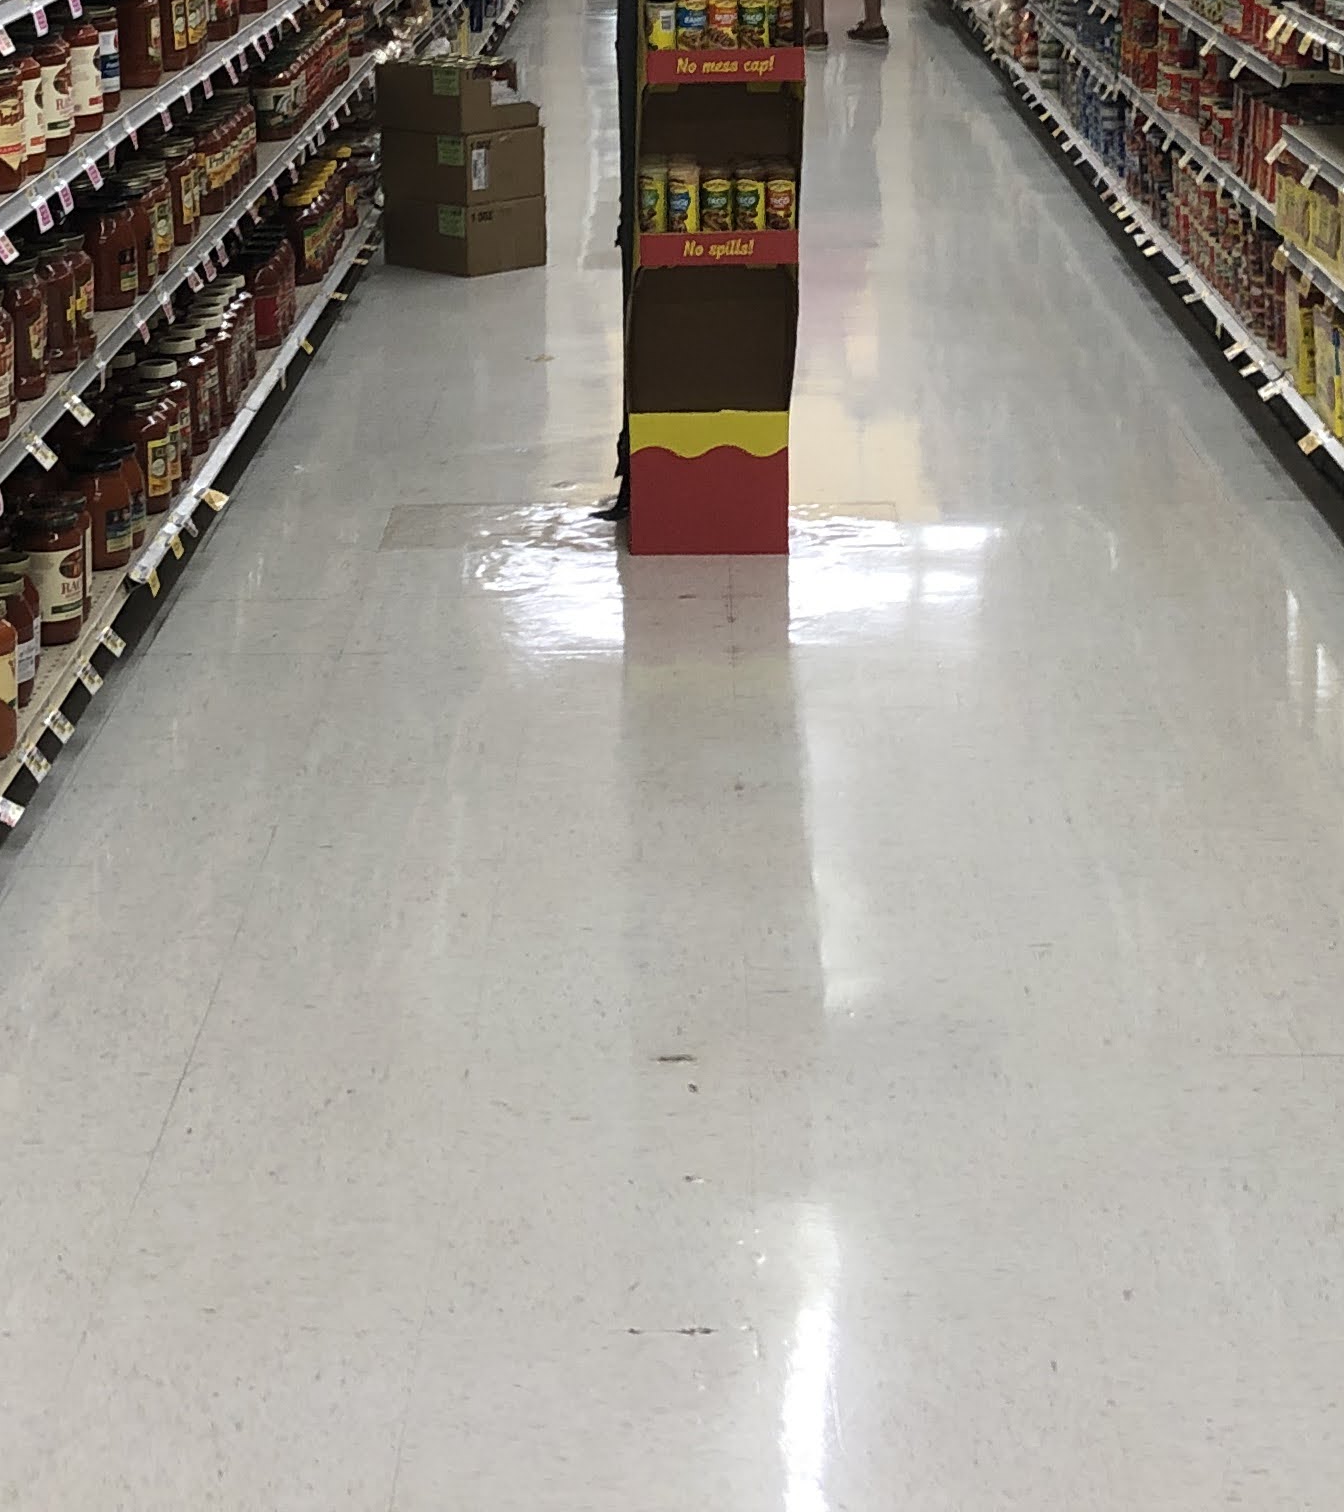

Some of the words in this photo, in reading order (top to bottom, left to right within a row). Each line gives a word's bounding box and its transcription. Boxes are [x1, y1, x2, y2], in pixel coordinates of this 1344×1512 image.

[676, 57, 697, 73] No
[703, 61, 738, 73] mess
[744, 56, 775, 76] cap!
[683, 241, 703, 256] No
[709, 239, 754, 259] spills!
